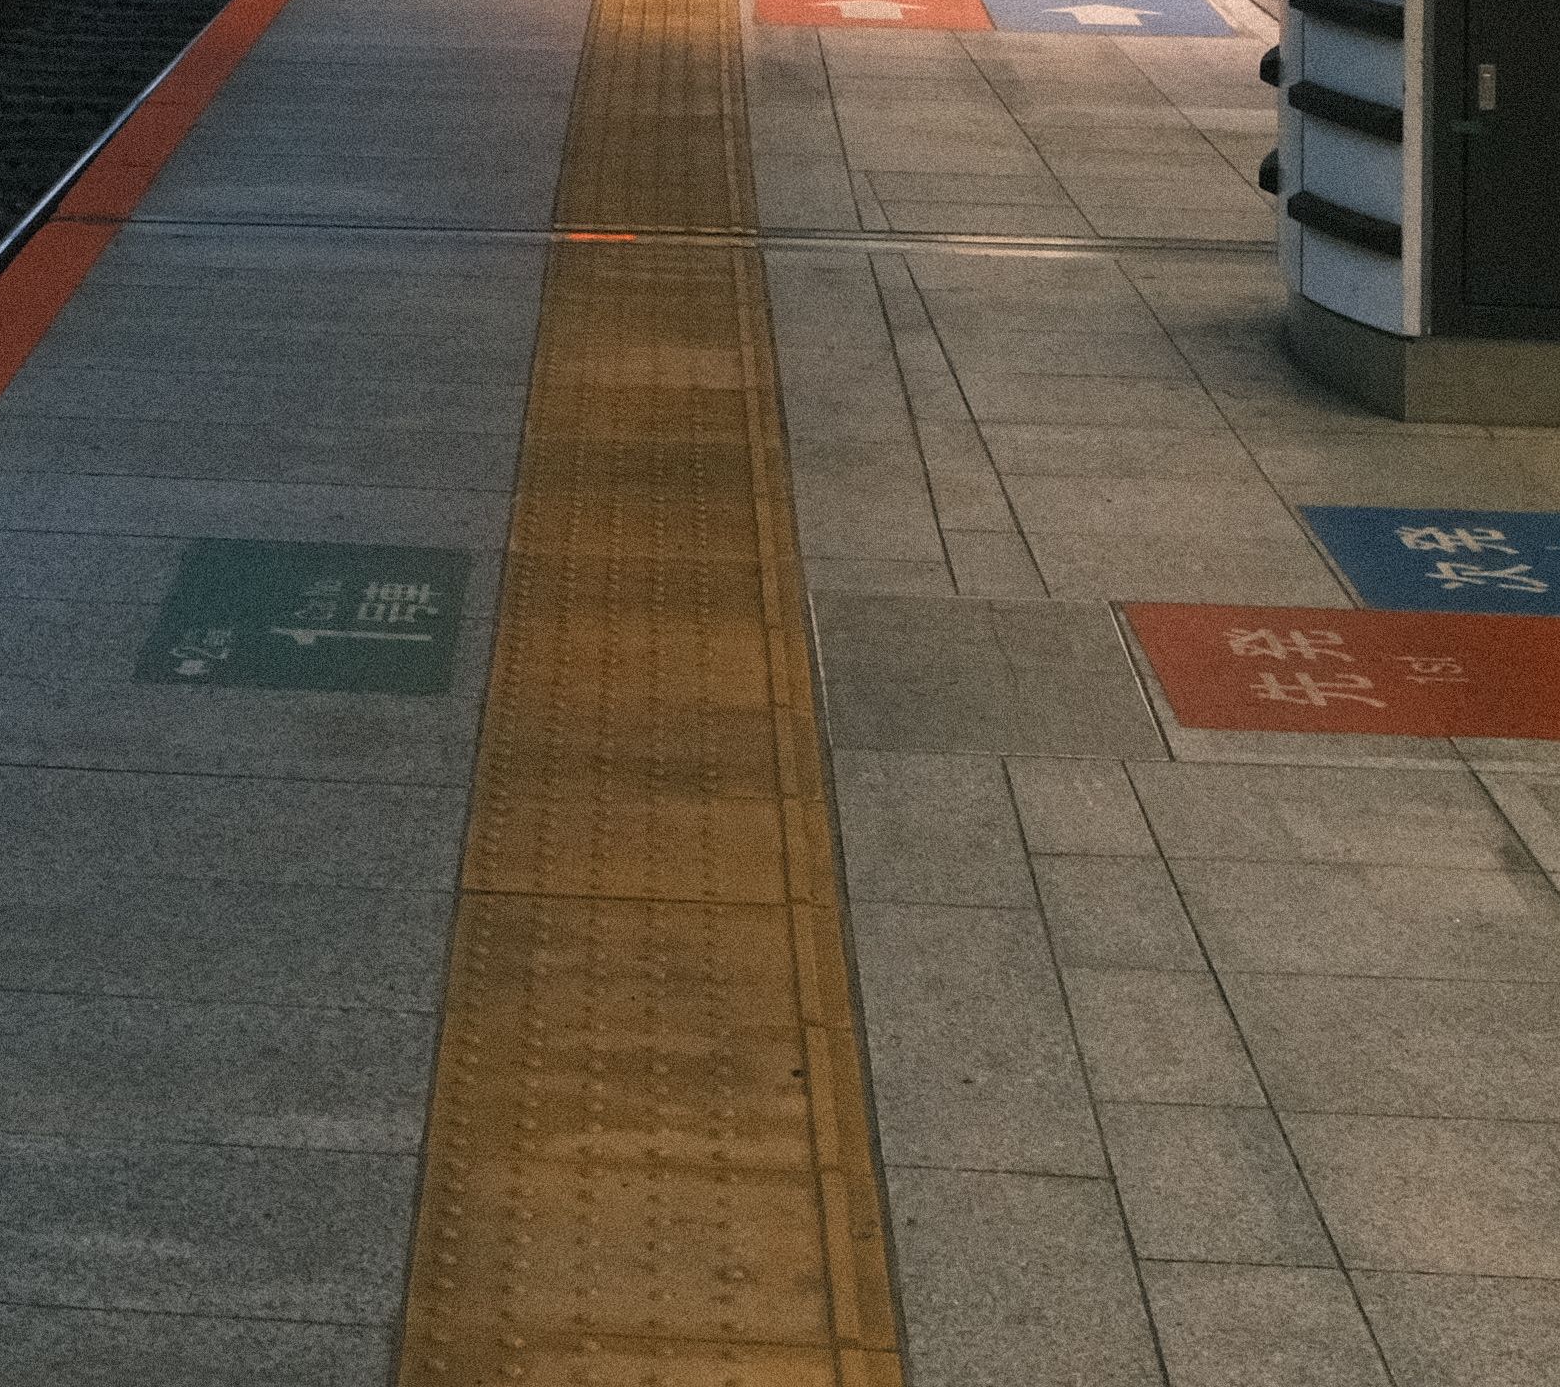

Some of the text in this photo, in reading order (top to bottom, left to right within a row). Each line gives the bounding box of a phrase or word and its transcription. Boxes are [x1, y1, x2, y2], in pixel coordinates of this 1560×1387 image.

[1394, 524, 1551, 594] 次発
[1223, 627, 1388, 710] 先発
[1392, 654, 1471, 685] 1st
